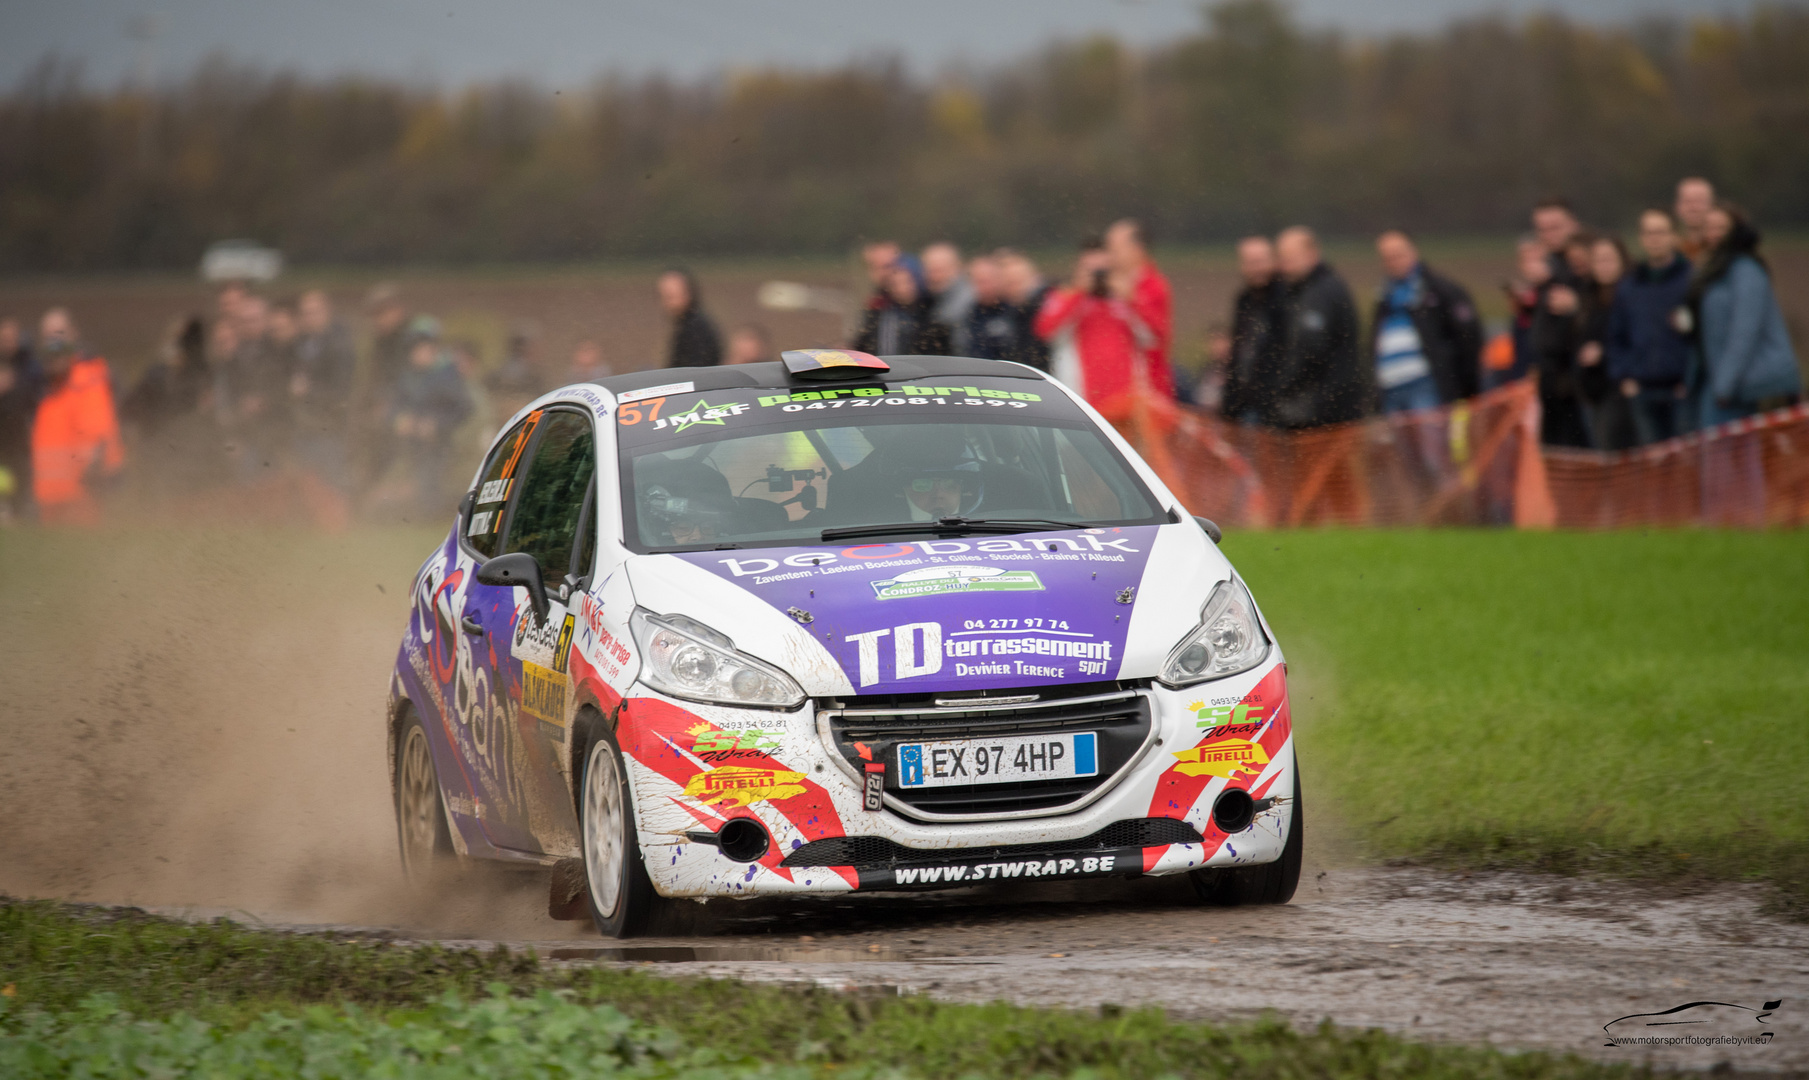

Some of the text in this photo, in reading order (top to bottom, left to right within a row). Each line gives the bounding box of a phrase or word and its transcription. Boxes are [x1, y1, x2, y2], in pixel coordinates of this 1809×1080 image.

[757, 385, 1042, 407] pare-brise
[782, 397, 1028, 412] 0472/081.599
[618, 397, 666, 426] 57
[652, 403, 751, 431] JM&F
[717, 534, 1140, 577] beobank
[752, 553, 1126, 585] Zaventem Laeken Bockstael St. Gilles Stockel Braine l'Alleud
[947, 570, 962, 578] 57
[901, 579, 938, 587] RALLYE
[963, 618, 1070, 630] 04 277 97 74
[845, 621, 942, 688] TD
[943, 637, 1113, 661] terrassement
[1078, 660, 1108, 676] sprl
[761, 720, 773, 728] 62
[776, 720, 788, 728] 81
[1201, 723, 1264, 739] Wrap
[699, 745, 784, 764] Wrap
[932, 747, 968, 778] EX
[1199, 743, 1253, 763] PIRELLI
[704, 771, 775, 791] PIRELLI
[895, 856, 1116, 885] WWW.STWRAP.BE
